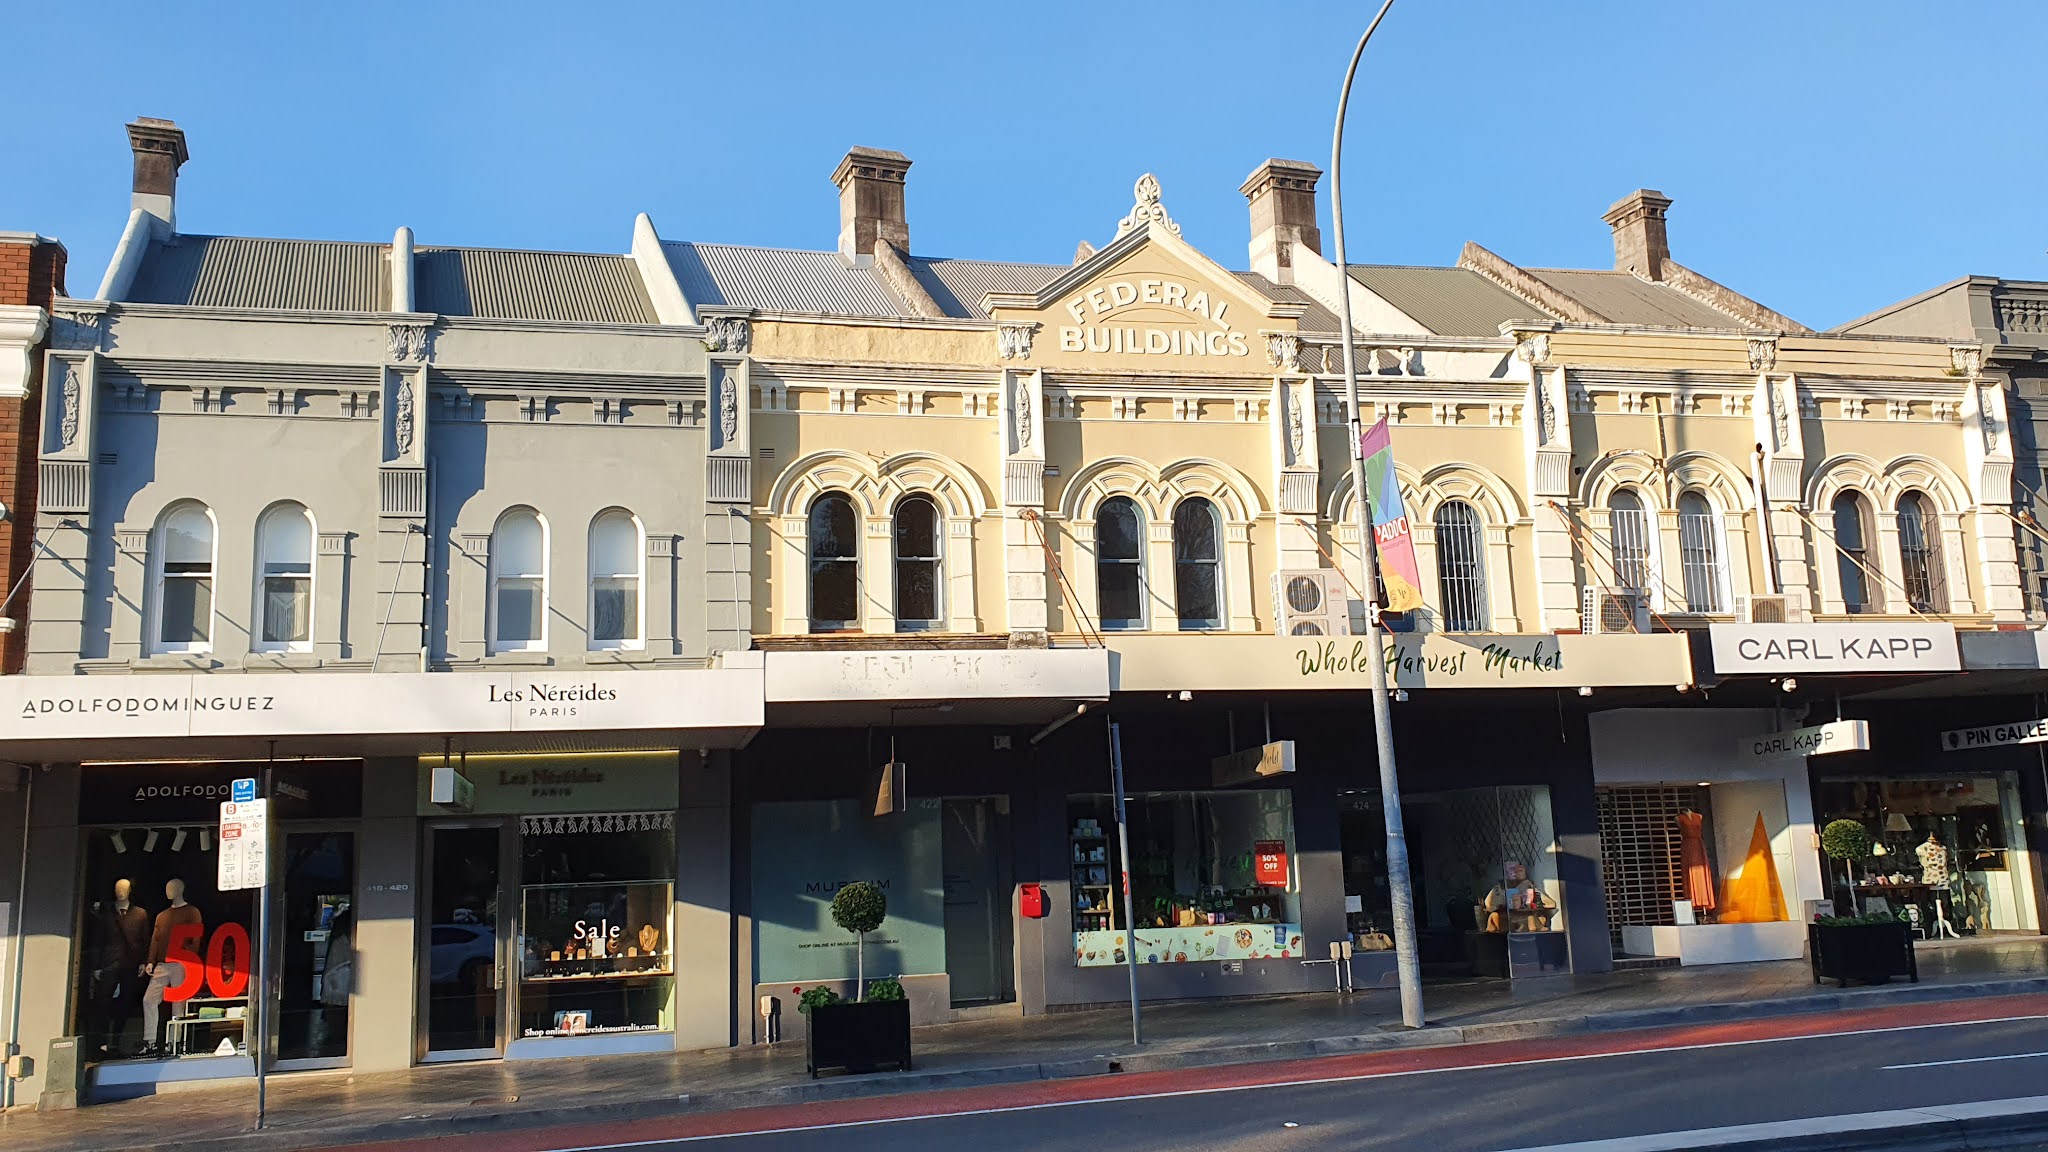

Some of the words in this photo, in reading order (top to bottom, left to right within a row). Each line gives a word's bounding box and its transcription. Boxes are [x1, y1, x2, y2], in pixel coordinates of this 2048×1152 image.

[1065, 279, 1232, 332] FEDERAL
[1059, 325, 1250, 357] BUILDINGS
[1738, 638, 1834, 661] CARL
[1840, 637, 1933, 659] KAPP
[1296, 640, 1367, 676] Whole
[1382, 643, 1467, 682] Harvest
[1481, 640, 1562, 679] Market
[488, 684, 523, 703] Les
[529, 682, 617, 702] Néréides
[22, 697, 275, 719] ADOLFODOMINGUEZ
[529, 707, 577, 717] PARIS
[1754, 740, 1792, 755] CARL
[1793, 731, 1834, 749] KAPP
[1966, 729, 1991, 745] PIN
[1995, 722, 2048, 741] GALLE
[135, 785, 229, 800] ADOLFODO
[1353, 801, 1369, 810] 424
[1262, 854, 1278, 862] 50%
[1264, 862, 1278, 870] OFF
[806, 880, 890, 893] MUSM
[573, 919, 621, 940] Sale
[163, 921, 250, 1003] 50
[524, 1028, 544, 1038] Shop
